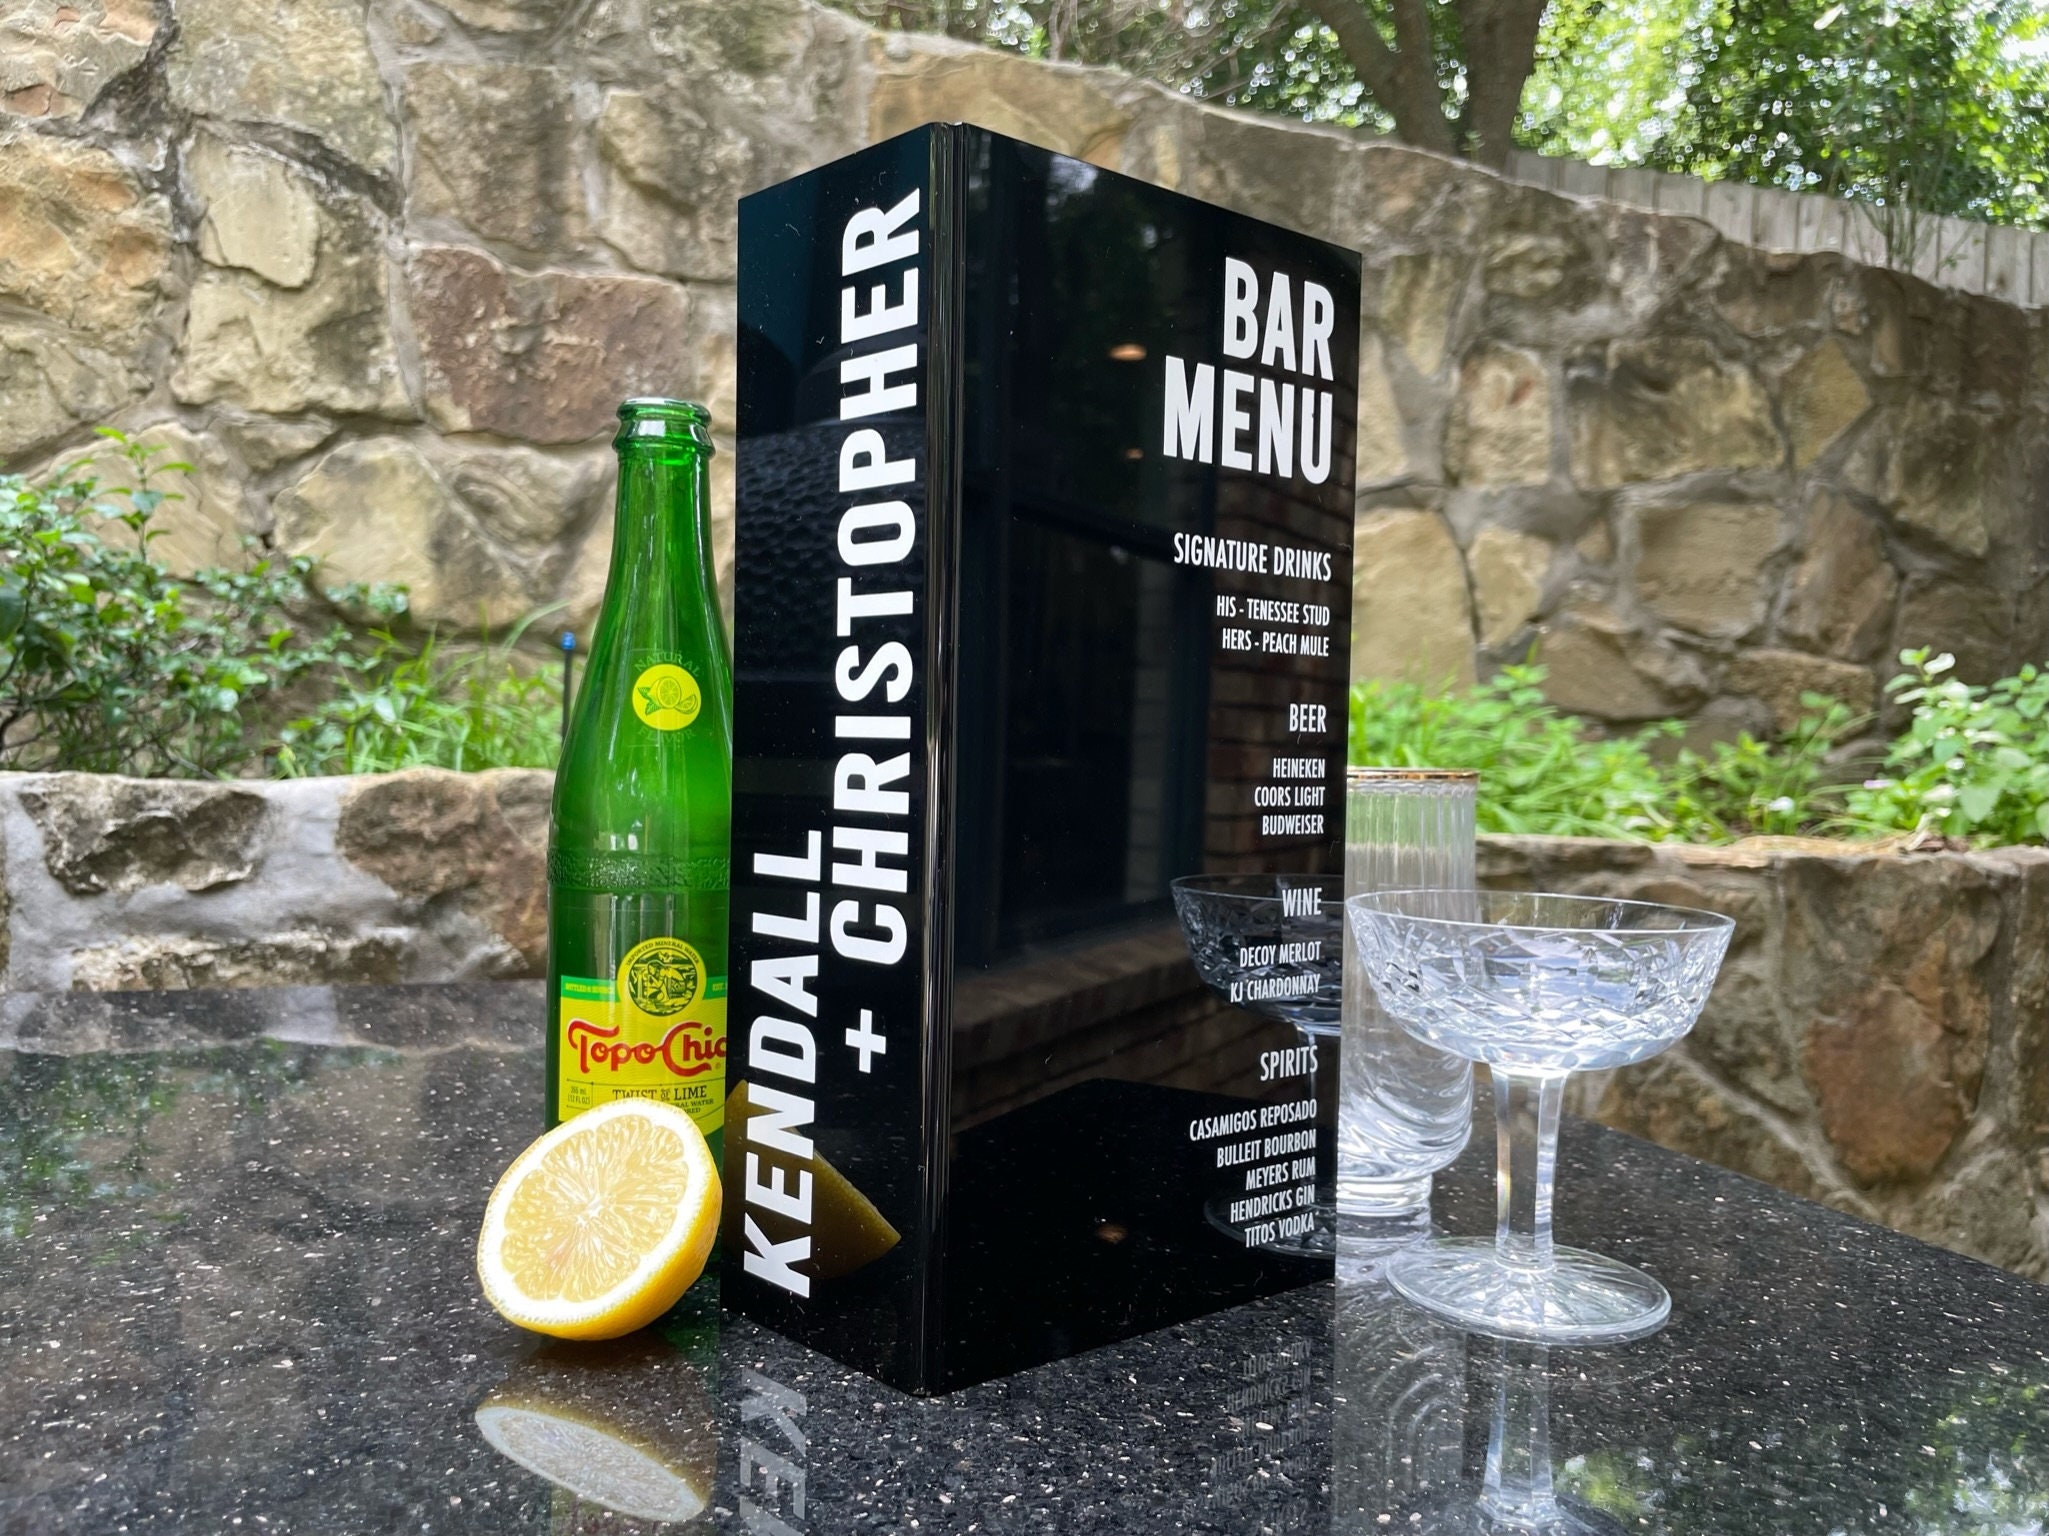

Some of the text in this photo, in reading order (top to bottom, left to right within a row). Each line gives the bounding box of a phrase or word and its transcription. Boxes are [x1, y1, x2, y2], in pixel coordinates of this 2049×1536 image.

[1223, 257, 1334, 381] BAR
[1163, 355, 1333, 484] MENU
[1173, 532, 1332, 582] SIGNATURE DRINKS
[829, 188, 920, 965] CHRISTOPHER
[1216, 595, 1236, 618] HIS
[1247, 598, 1300, 625] TENESSEE
[1303, 604, 1330, 627] STUD
[1222, 628, 1252, 651] HERS
[1262, 632, 1297, 655] PEACH
[1300, 635, 1329, 657] MULE
[634, 651, 700, 677] NATURAL
[1289, 703, 1327, 733] BEER
[1272, 758, 1325, 779] HEINEKEN
[1254, 786, 1325, 807] COORS LIGHT
[1262, 815, 1324, 836] BUDWEISER
[1282, 887, 1323, 918] WINE
[1239, 941, 1322, 968] DECOY MERLOT
[1230, 974, 1321, 1003] KJ CHARDONNAY
[567, 1018, 727, 1078] Topo Chic
[744, 830, 821, 1298] KENDALL
[1260, 1045, 1318, 1082] SPIRITS
[612, 1089, 658, 1101] TWIST
[674, 1085, 707, 1101] LIME
[690, 1098, 714, 1107] WATER
[1189, 1098, 1317, 1141] CASAMIGOS REPOSADO
[1216, 1128, 1317, 1168] BULLEIT BOURBON
[1245, 1156, 1316, 1191] MEYERS RUM
[1230, 1184, 1315, 1223] HENDRICKS GIN
[1244, 1212, 1315, 1248] TITOS VODKA
